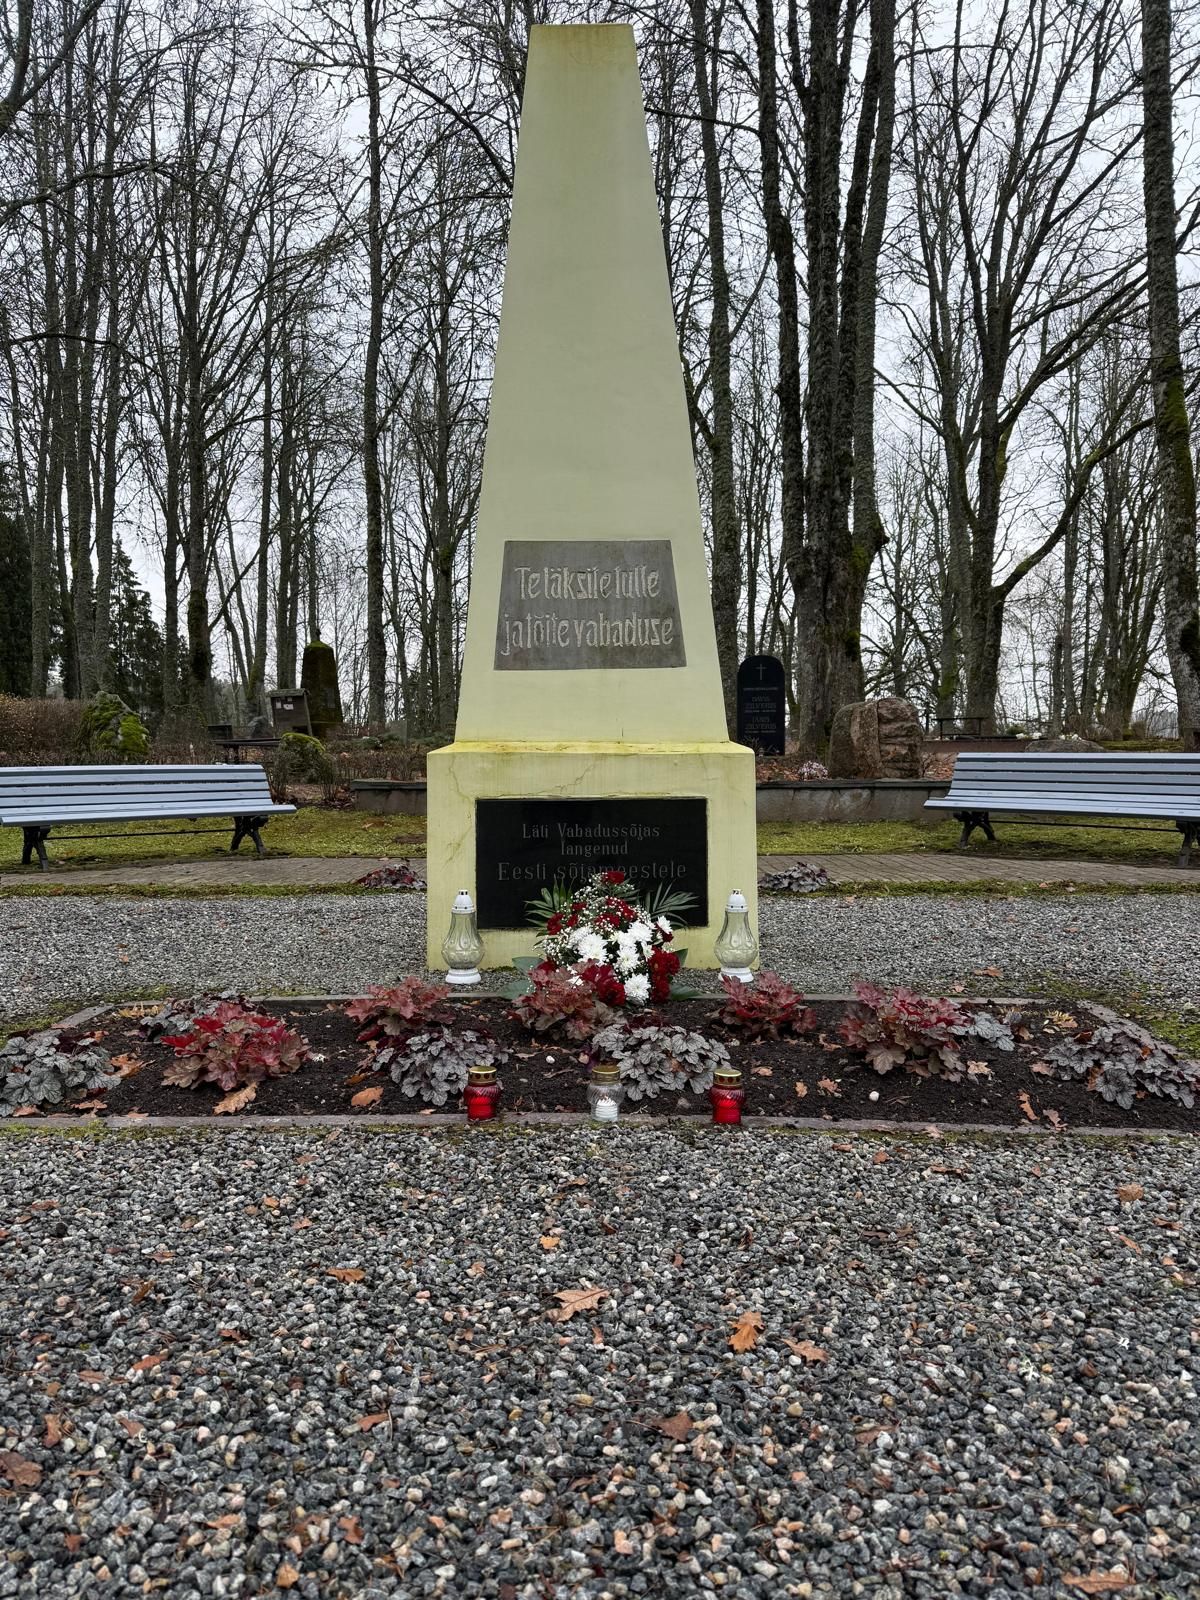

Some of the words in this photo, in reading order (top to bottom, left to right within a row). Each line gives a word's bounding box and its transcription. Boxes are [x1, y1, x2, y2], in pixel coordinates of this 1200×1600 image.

[514, 566, 541, 600] Te
[544, 566, 612, 600] läksite
[614, 564, 661, 599] tulle
[501, 613, 523, 656] ja
[526, 612, 570, 649] tõite
[573, 611, 674, 648] vabaduse
[522, 823, 549, 839] Läti
[557, 822, 661, 841] Vabadussõjas
[560, 840, 629, 857] langenud
[497, 862, 546, 881] Eesti
